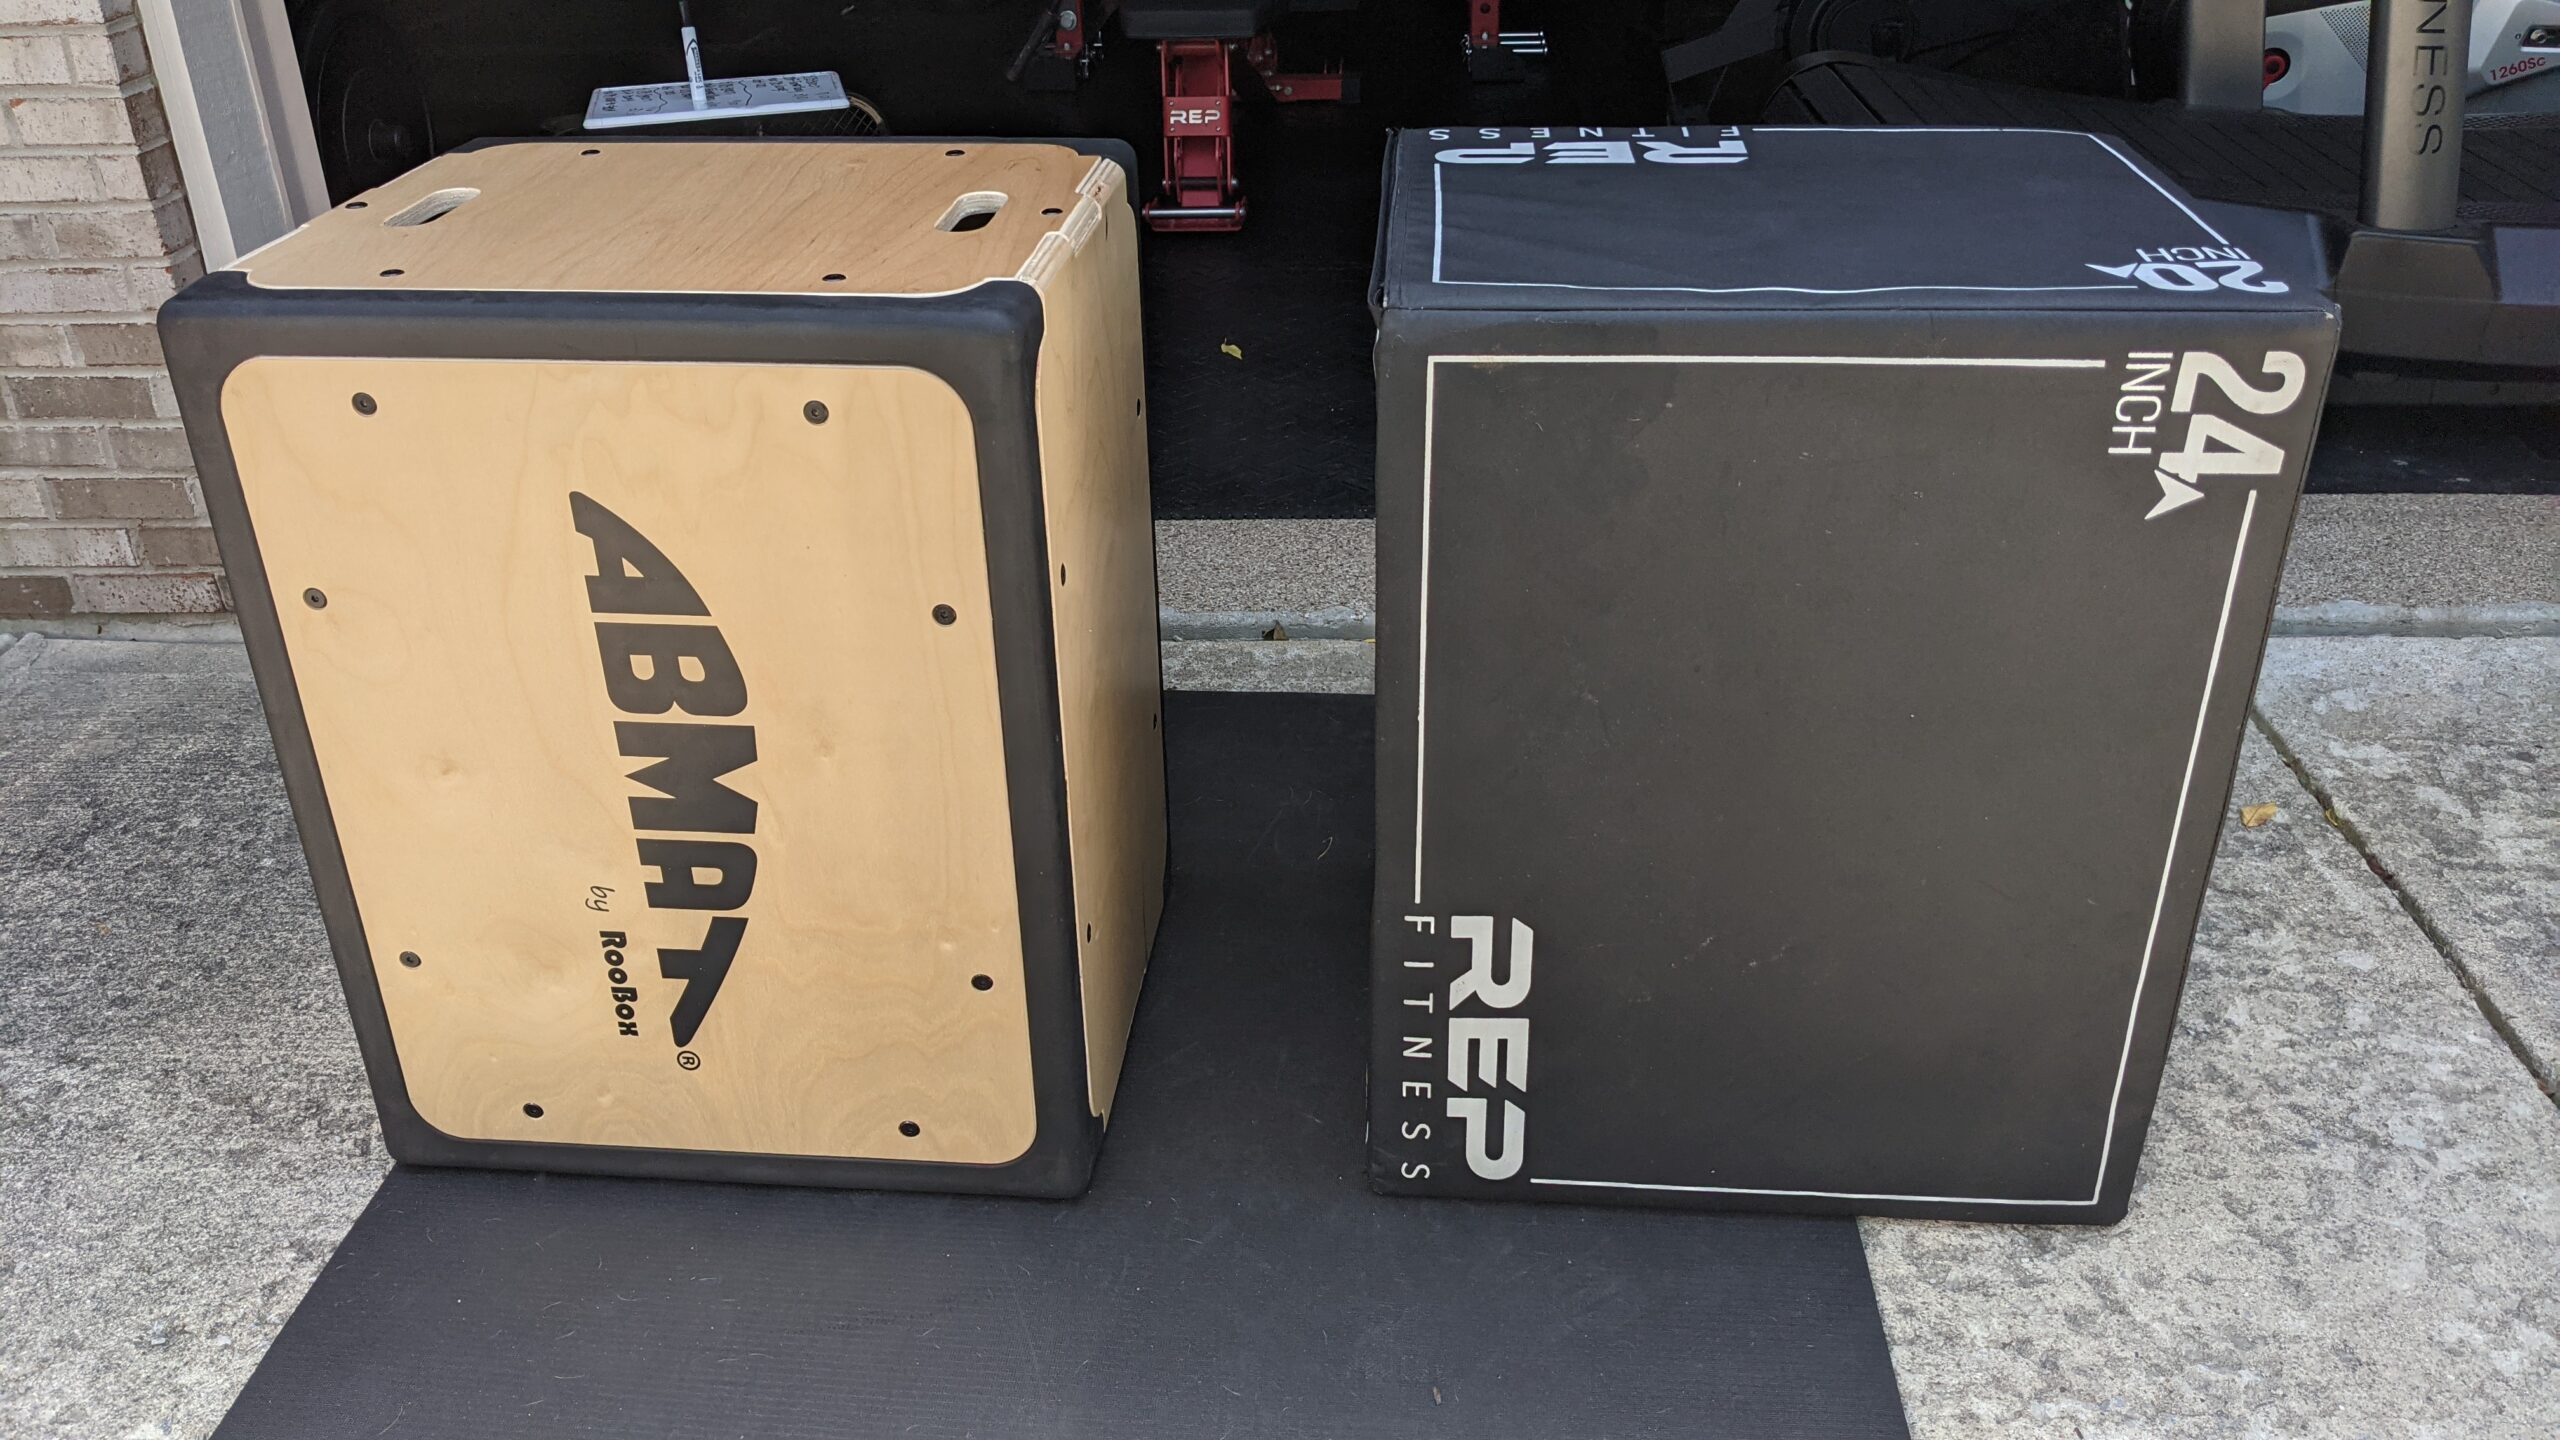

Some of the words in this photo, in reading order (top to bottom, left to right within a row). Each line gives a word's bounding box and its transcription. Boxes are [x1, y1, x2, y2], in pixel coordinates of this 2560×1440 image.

[1170, 109, 1221, 124] REP
[1429, 126, 1739, 140] FITNESS
[1434, 140, 1748, 164] REP
[2136, 246, 2250, 262] INCH
[2133, 260, 2290, 293] 20
[2107, 352, 2174, 454] INCH
[2158, 350, 2306, 484] 24
[585, 885, 616, 913] by
[599, 930, 640, 1037] RooBox
[1401, 915, 1435, 1179] FITNESS
[1446, 915, 1534, 1180] REP
